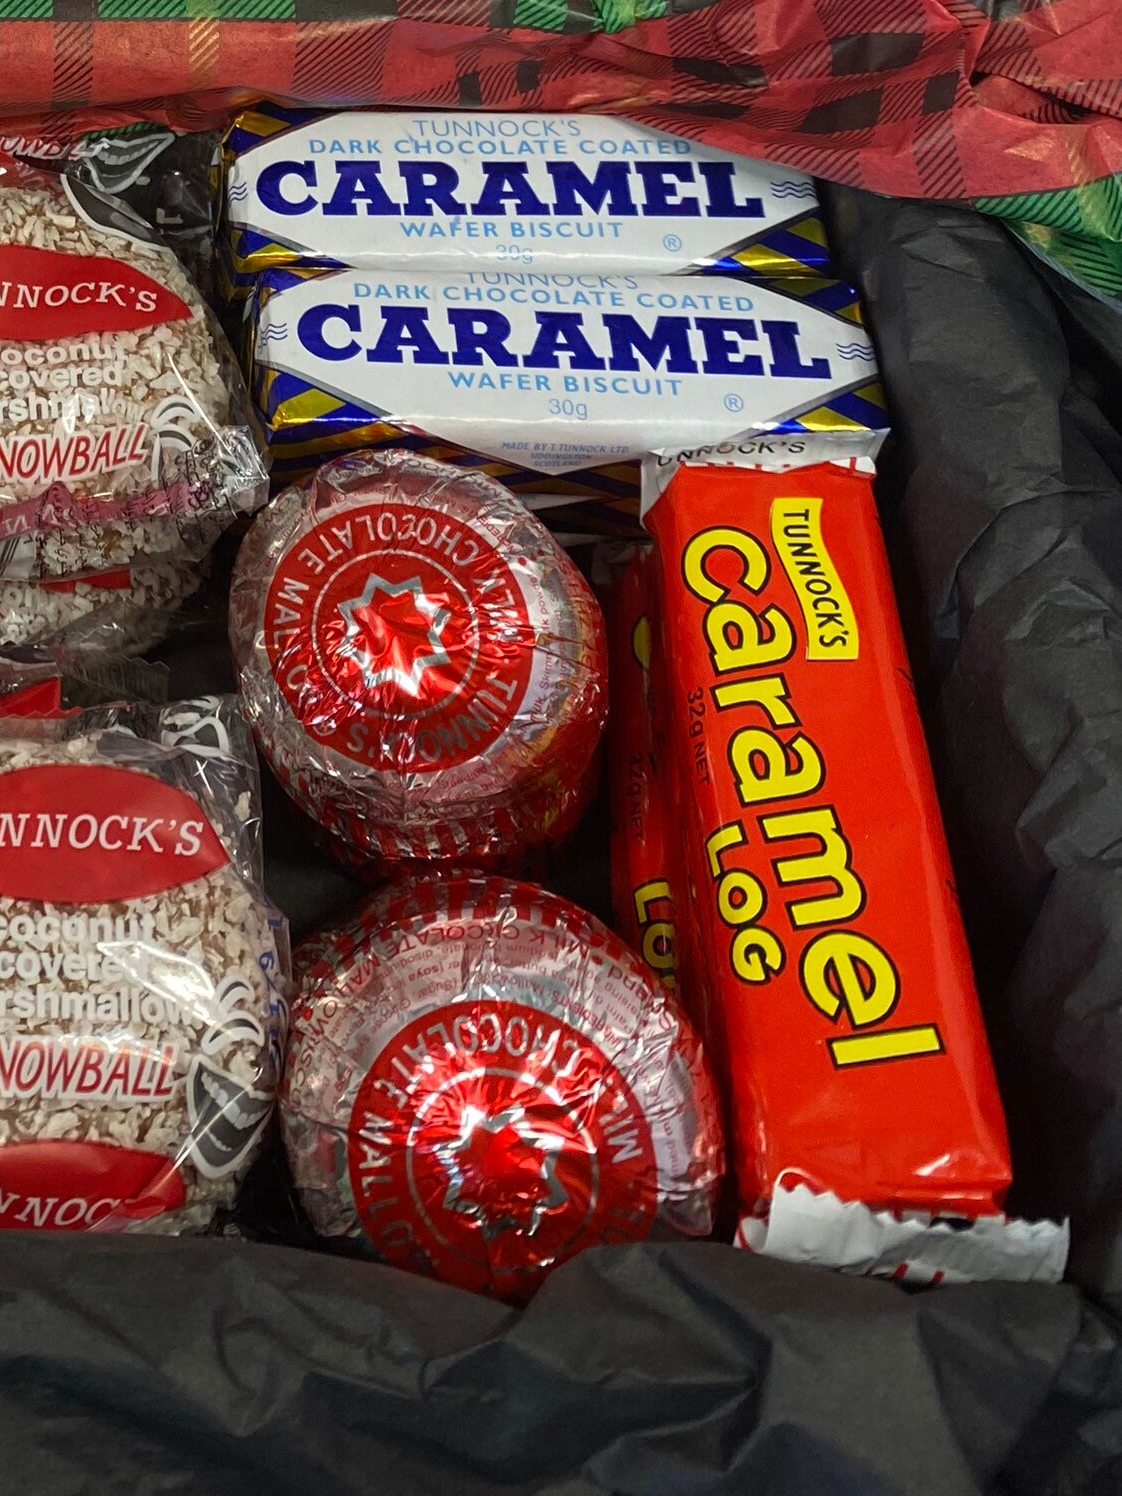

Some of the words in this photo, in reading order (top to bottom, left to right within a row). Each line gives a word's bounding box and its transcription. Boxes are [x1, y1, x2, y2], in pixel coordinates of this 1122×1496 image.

[309, 139, 383, 154] DARK
[394, 139, 568, 155] CHOCOLATE
[579, 139, 691, 155] COATED
[412, 119, 581, 137] TUNNOCK'S
[256, 160, 766, 218] CARAMEL
[399, 221, 499, 238] WAFER
[510, 221, 623, 238] BISCUIT
[495, 244, 534, 265] 30g
[353, 282, 431, 300] DARK
[442, 285, 624, 307] CHOCOLATE
[636, 292, 754, 312] COATED
[466, 271, 639, 290] TUNNOCK'S
[296, 303, 833, 380] CARAMEL
[448, 371, 551, 392] WAFER
[563, 375, 683, 397] BISCUIT
[548, 398, 589, 421] 30g
[501, 441, 529, 451] MADE
[533, 442, 548, 452] BY
[657, 439, 807, 467] UNNOCK'S
[296, 511, 481, 575] CHOCOLATE
[782, 508, 851, 649] TUNNOCK'S
[687, 686, 707, 737] 32g
[692, 742, 710, 785] NET
[681, 525, 946, 1071] Caramel
[705, 819, 787, 986] LOG
[526, 925, 592, 961] MILK
[633, 878, 677, 990] LO
[374, 1012, 581, 1109] CHOCOLATE
[358, 1110, 416, 1248] MALLO
